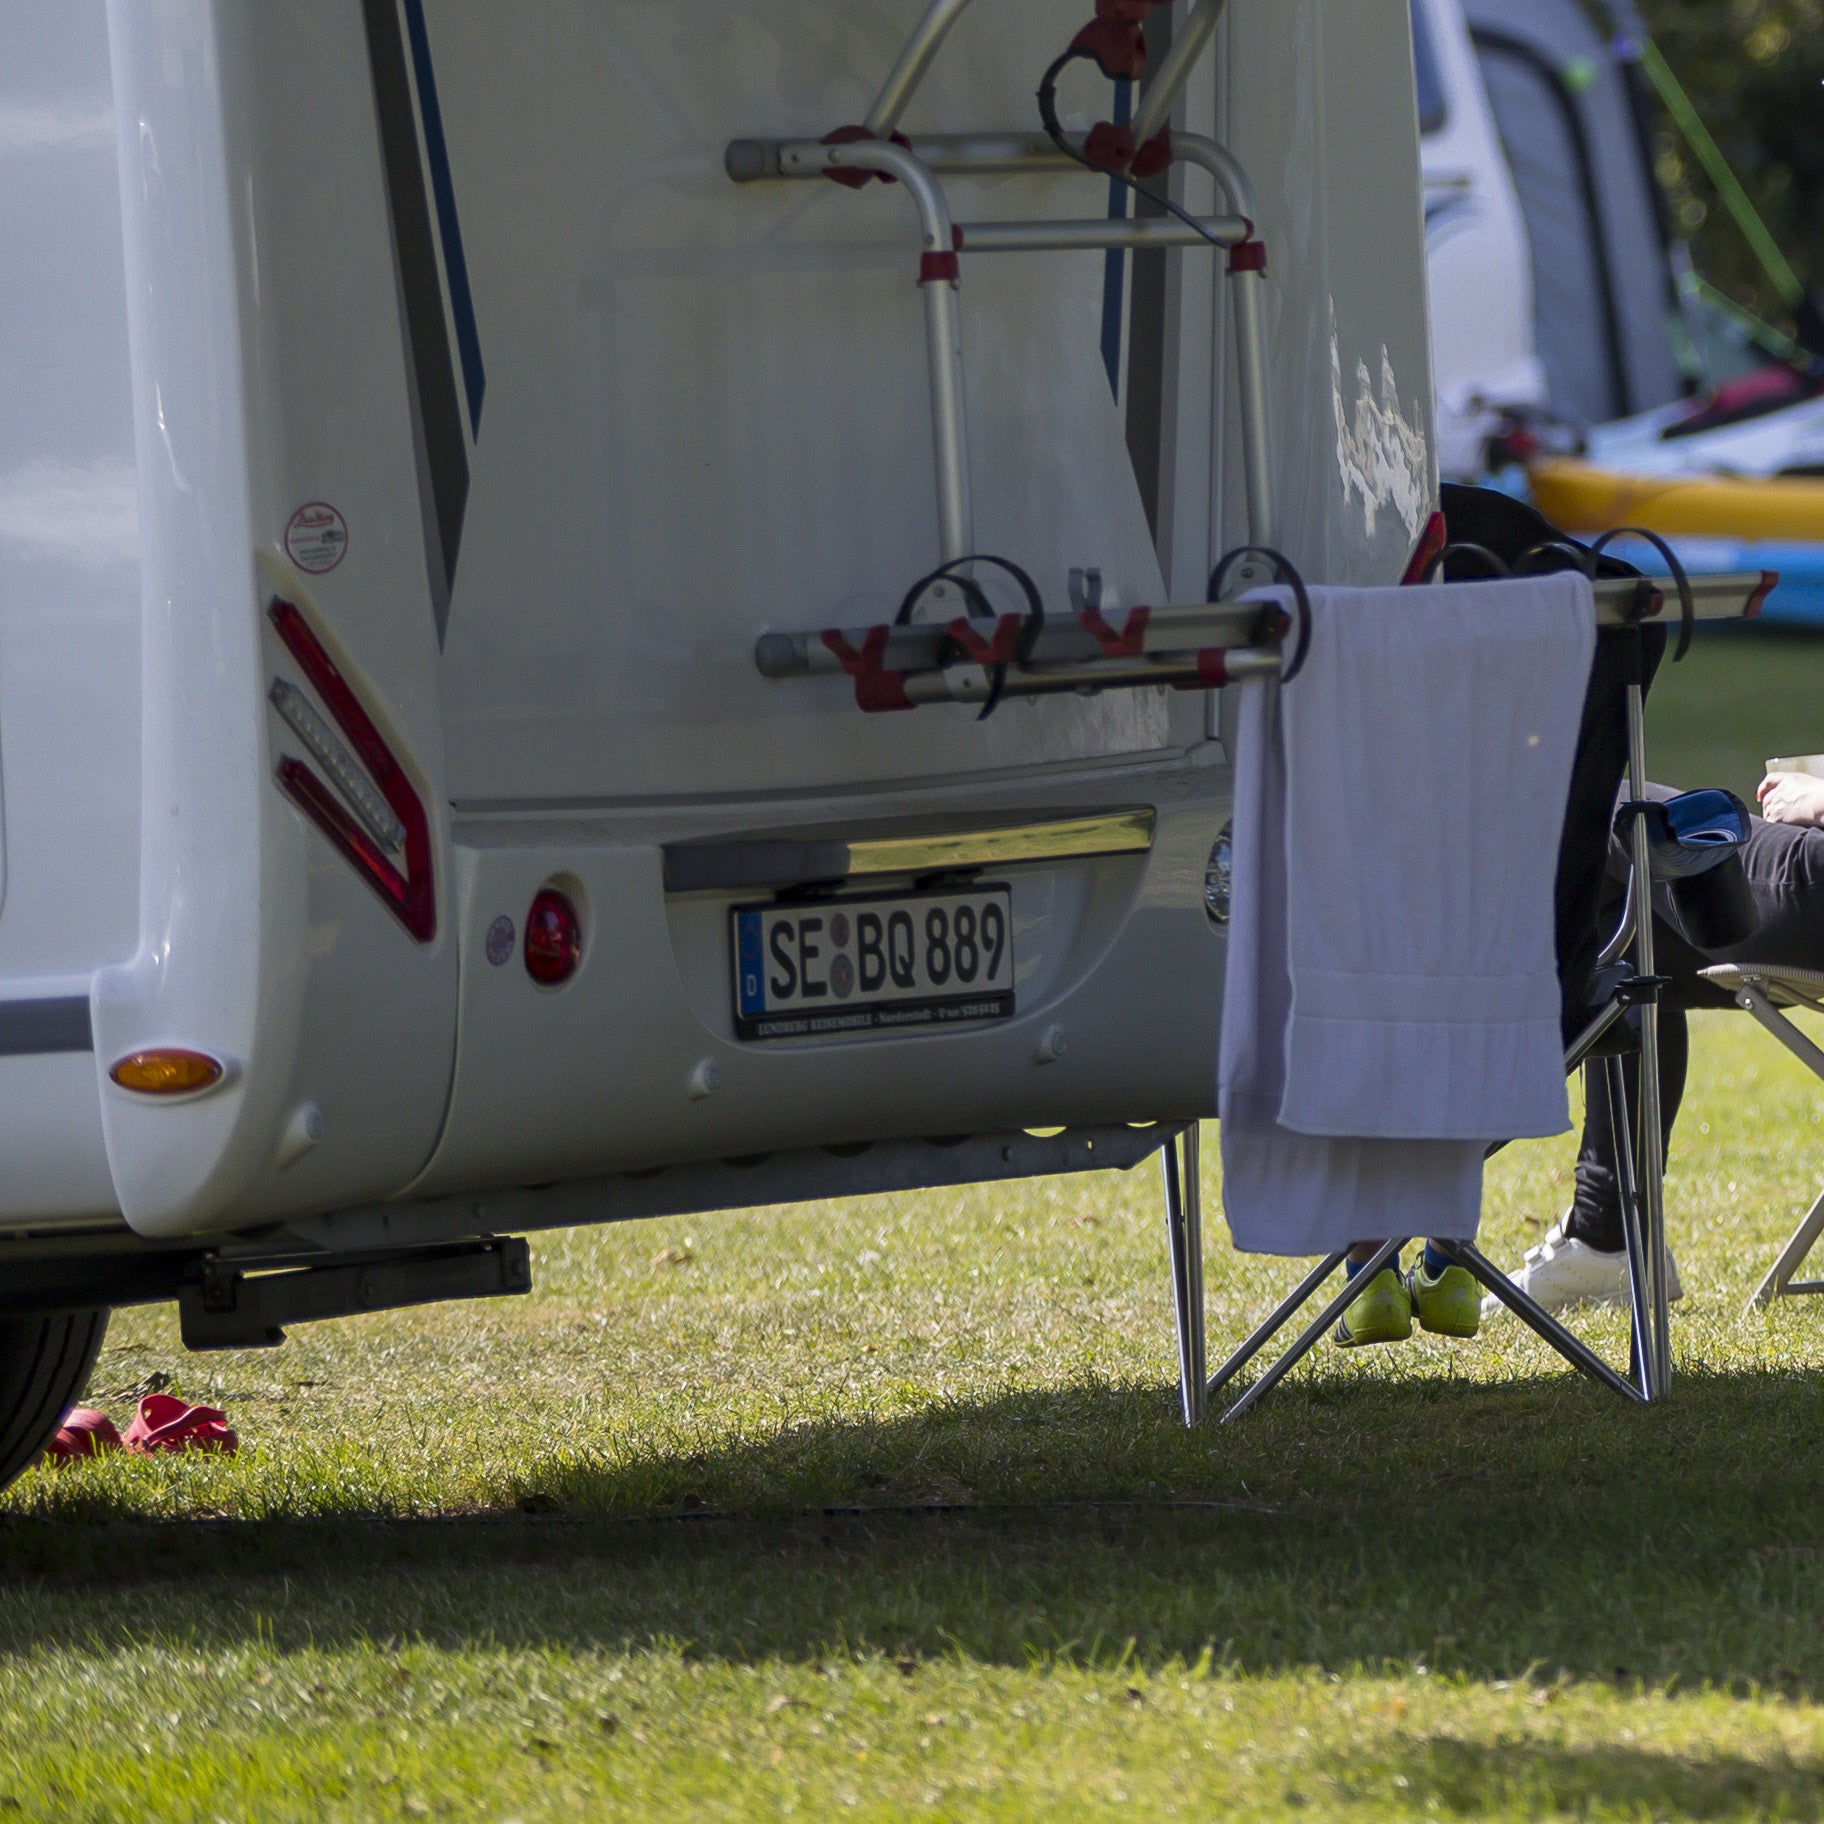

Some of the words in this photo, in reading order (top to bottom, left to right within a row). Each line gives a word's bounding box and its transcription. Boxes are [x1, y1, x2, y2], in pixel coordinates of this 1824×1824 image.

[770, 919, 827, 999] SE
[856, 909, 916, 992] BQ
[925, 902, 1005, 985] 889
[746, 974, 758, 996] D
